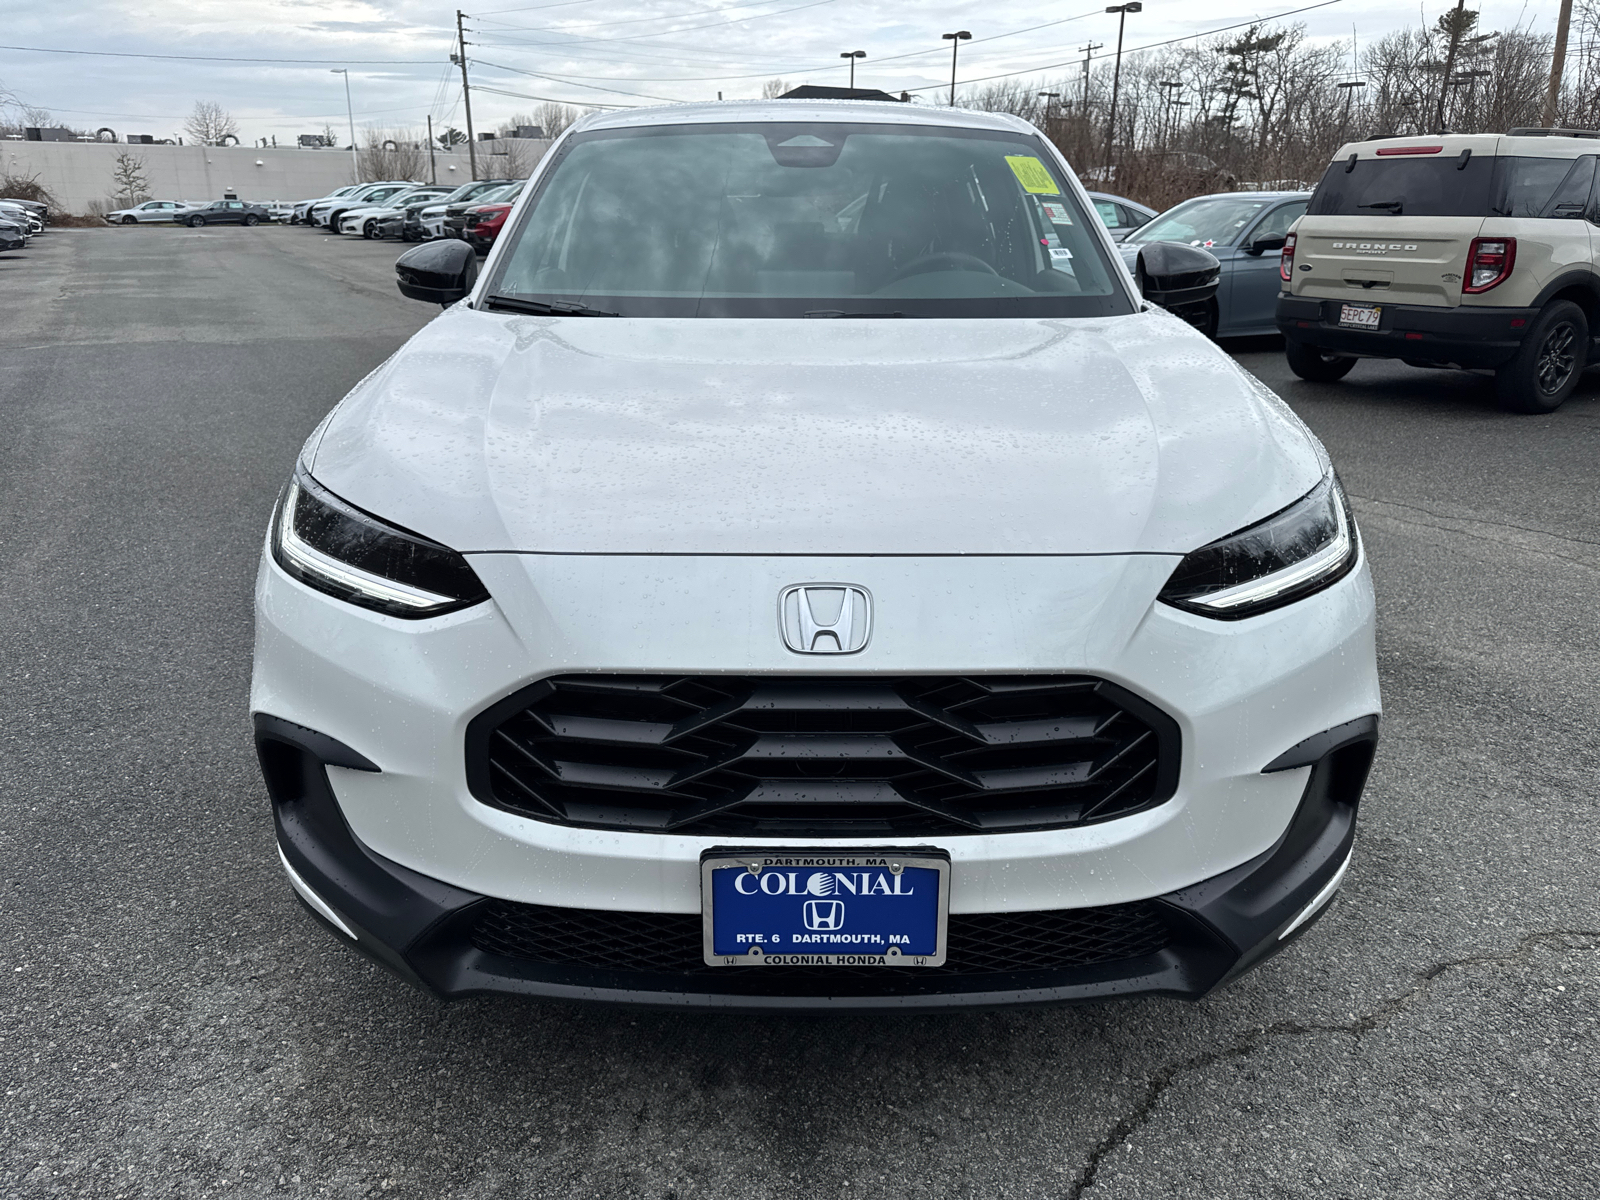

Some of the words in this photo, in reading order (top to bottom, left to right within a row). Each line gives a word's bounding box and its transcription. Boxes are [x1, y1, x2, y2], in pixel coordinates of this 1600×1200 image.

[1332, 242, 1418, 251] BRONCO
[1341, 308, 1365, 322] 5EPC
[1366, 310, 1379, 323] 79
[764, 858, 860, 866] DARTMOUTH,
[865, 858, 888, 866] MA
[734, 872, 914, 896] COLONIAL
[736, 934, 768, 943] RTE.
[771, 934, 781, 943] 6
[792, 934, 885, 945] DARTMOUTH,
[889, 934, 911, 944] MA
[764, 955, 833, 965] COLONIAL
[836, 955, 887, 965] HONDA
